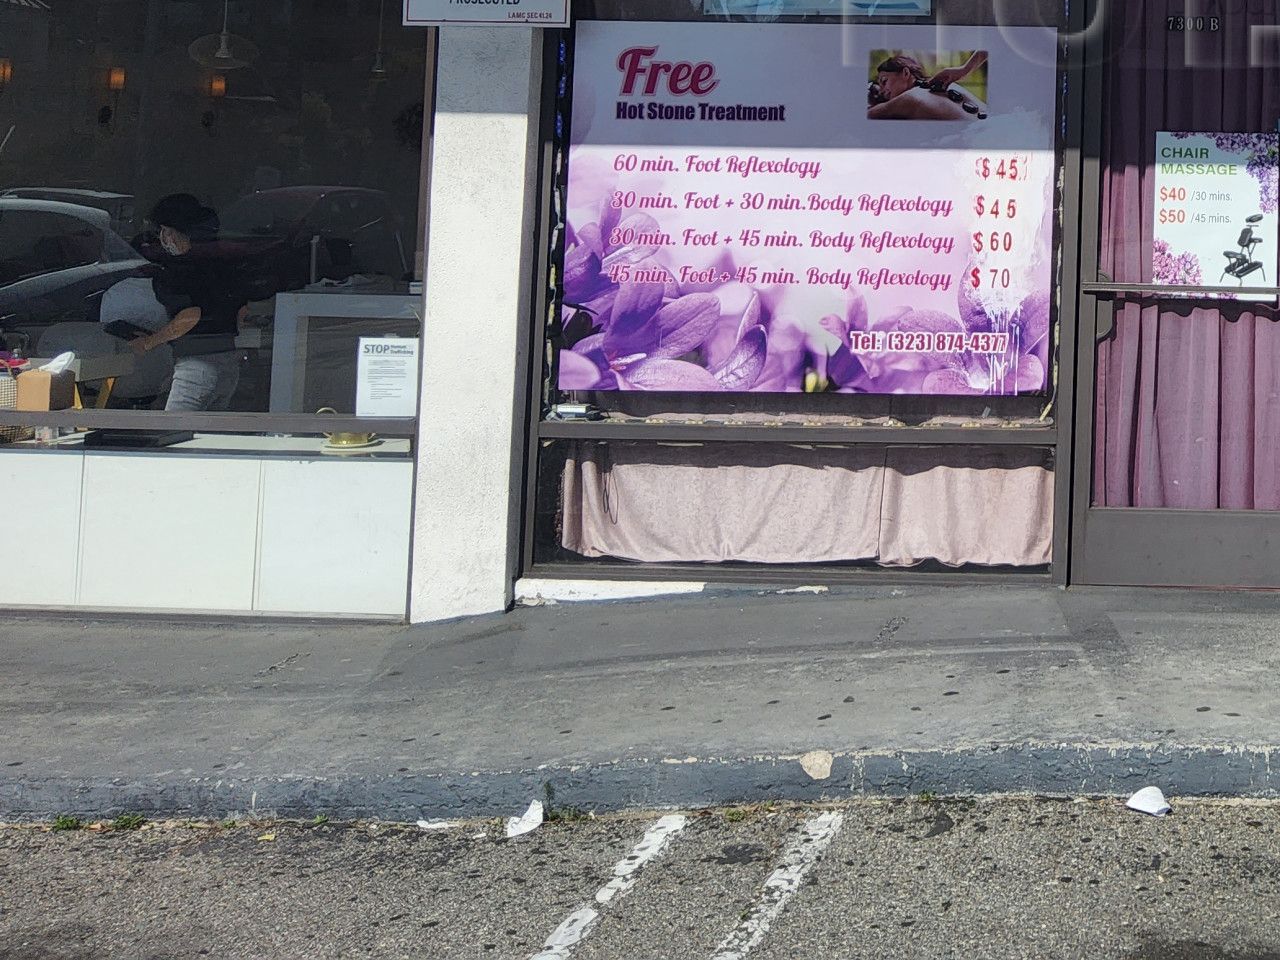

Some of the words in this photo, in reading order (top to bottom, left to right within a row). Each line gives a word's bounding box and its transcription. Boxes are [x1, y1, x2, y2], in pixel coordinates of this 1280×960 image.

[1168, 17, 1203, 30] 7300
[1210, 18, 1219, 31] B
[617, 46, 720, 96] Free
[616, 102, 644, 120] Hot
[647, 103, 695, 120] Stone
[698, 103, 786, 122] Treatment
[1161, 147, 1209, 158] CHAIR
[614, 154, 637, 171] 60
[640, 156, 679, 172] min.
[686, 155, 723, 173] Foot
[726, 155, 822, 179] Reflexology
[1161, 164, 1237, 175] MASSAGE
[612, 191, 635, 208] 30
[639, 193, 678, 209] min.
[684, 192, 721, 209] Foot
[725, 199, 734, 207] +
[740, 192, 764, 210] 30
[858, 194, 953, 216] Reflexology
[1160, 186, 1186, 202] $40
[1209, 191, 1232, 201] mins.
[1159, 208, 1185, 224] $50
[1209, 214, 1231, 224] mins.
[611, 228, 634, 245] 30
[638, 230, 676, 246] min.
[683, 229, 719, 246] Foot
[724, 236, 733, 244] +
[739, 230, 760, 246] 45
[764, 231, 803, 247] min.
[809, 230, 855, 252] Body
[860, 231, 955, 254] Reflexology
[609, 265, 630, 282] 45
[634, 267, 673, 283] min.
[679, 266, 717, 283] Foot
[720, 273, 730, 281] +
[736, 267, 758, 283] 45
[761, 268, 800, 284] min.
[807, 267, 852, 290] Body
[857, 268, 953, 291] Reflexology
[364, 344, 389, 353] STOP
[852, 332, 882, 351] Tel:
[888, 334, 932, 351] (323)
[936, 334, 1007, 352] 874-4377
